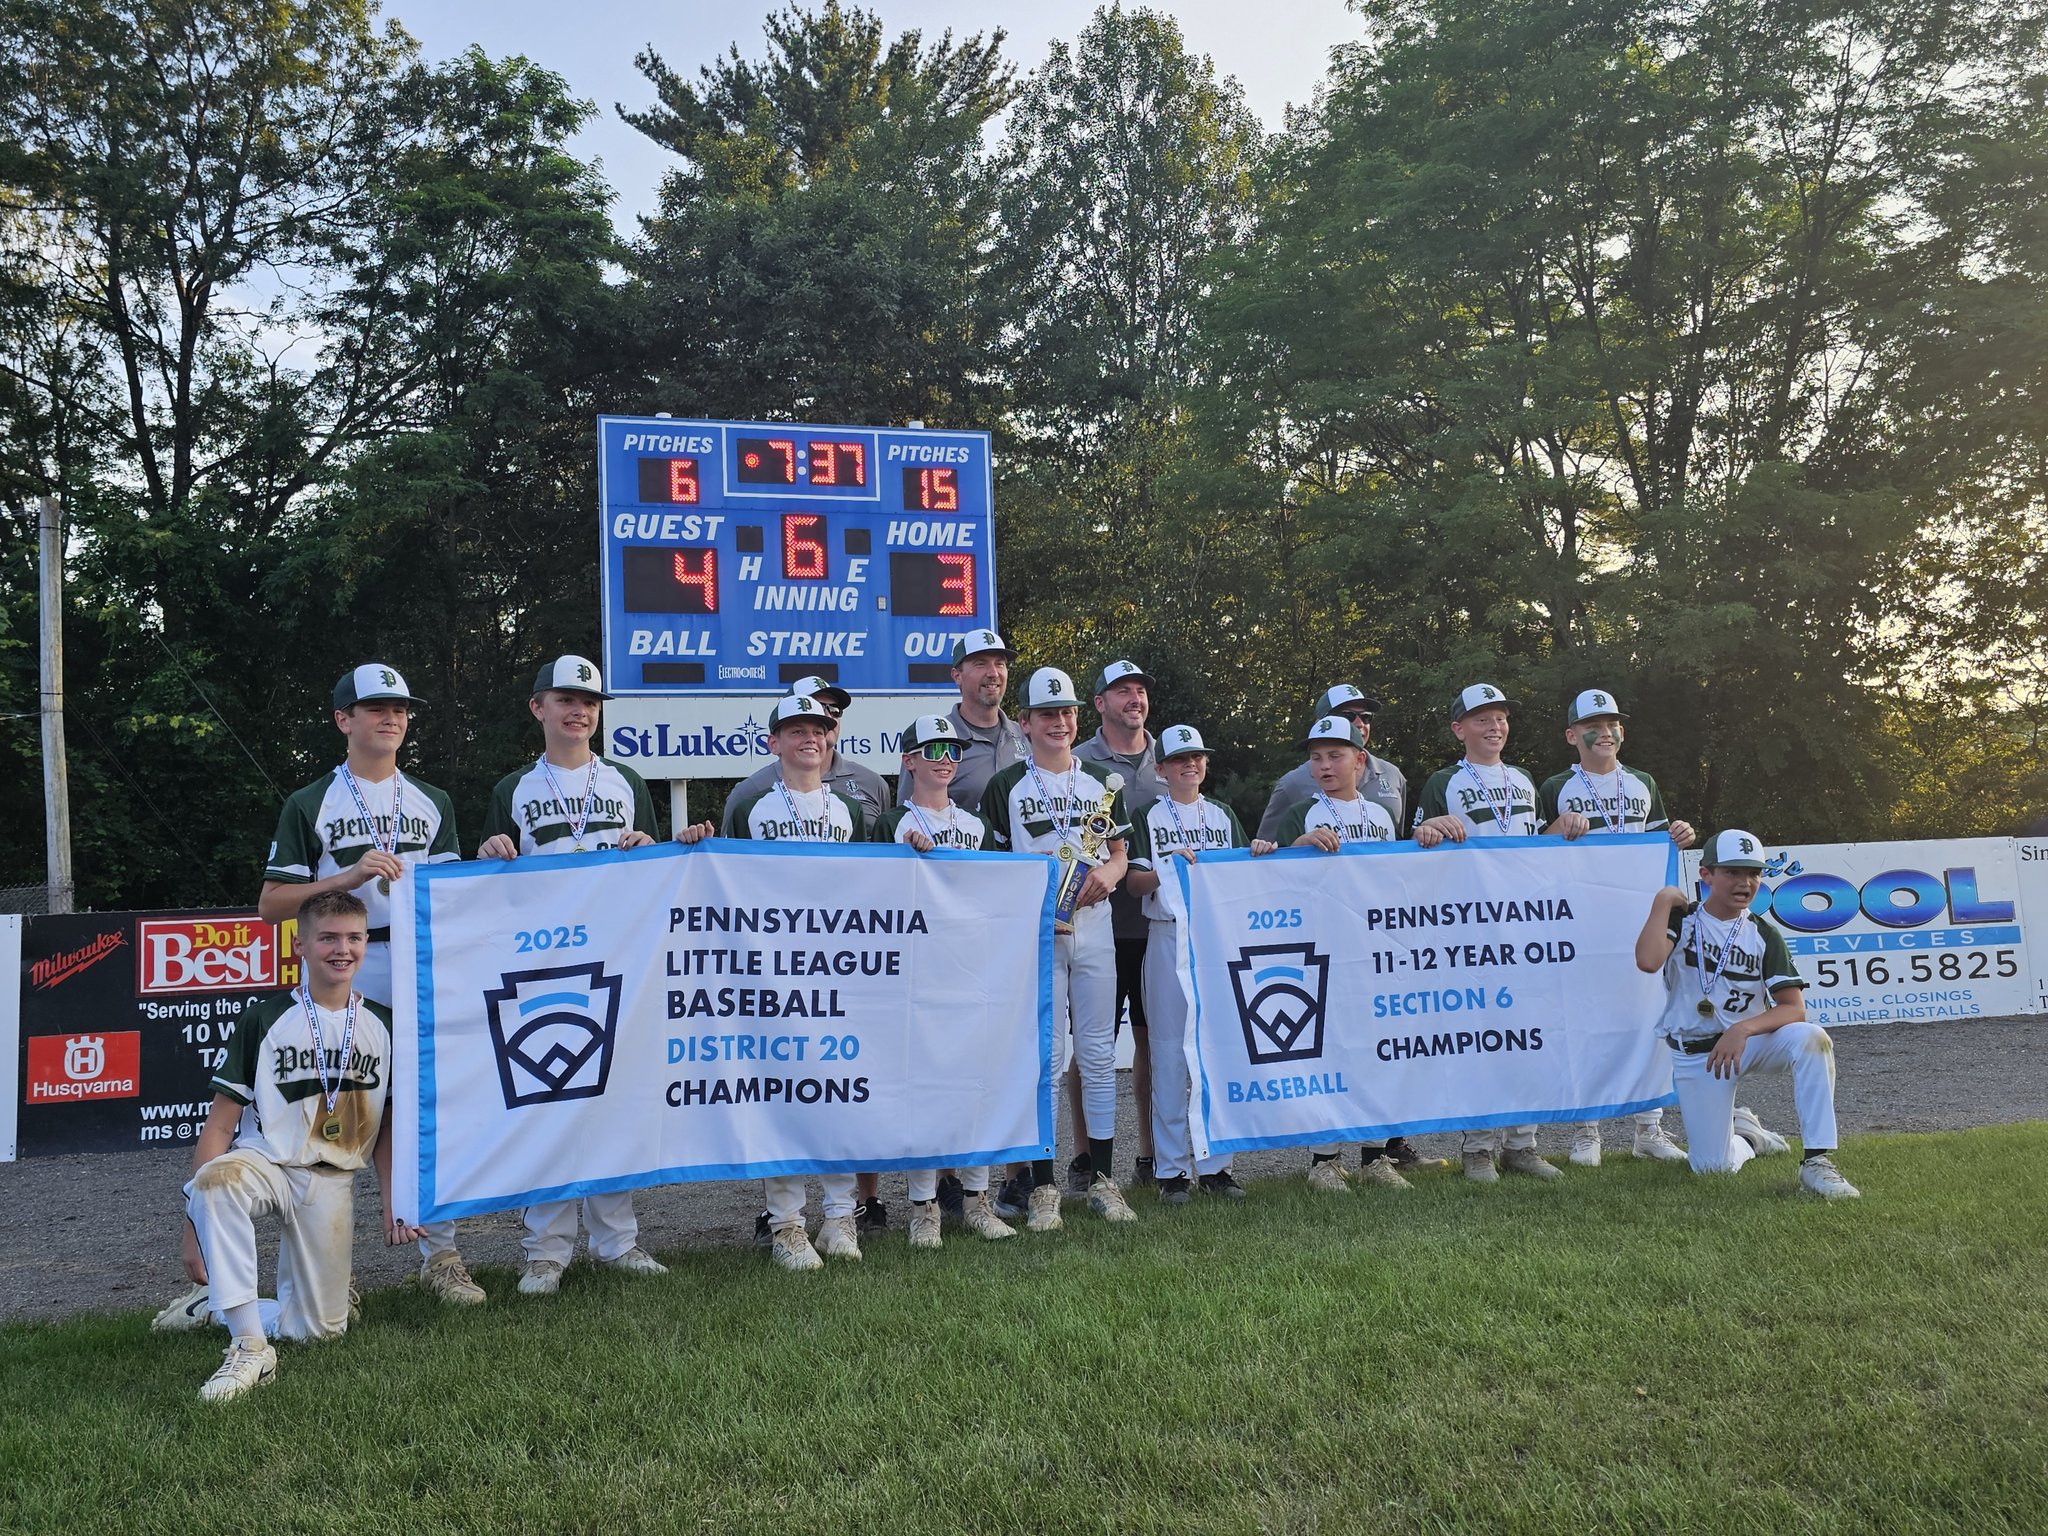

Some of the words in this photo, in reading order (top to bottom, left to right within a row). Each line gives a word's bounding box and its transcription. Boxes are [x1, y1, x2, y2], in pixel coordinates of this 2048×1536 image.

[624, 434, 713, 453] PITCHES
[887, 445, 970, 463] PITCHES
[670, 460, 697, 503] 6
[920, 468, 958, 510] 15
[613, 513, 725, 541] GUEST
[886, 522, 977, 547] HOME
[785, 515, 824, 578] 6
[674, 549, 715, 612] 4
[738, 556, 763, 581] H
[847, 559, 870, 583] E
[937, 554, 974, 615] 3
[753, 586, 859, 611] INNING
[628, 630, 718, 656] BALL
[746, 631, 868, 657] STRIKE
[904, 632, 965, 658] OUT
[521, 793, 624, 829] Pennrdge
[1566, 795, 1647, 815] Pennrdge
[324, 814, 430, 848] Pennrdge
[2021, 845, 2048, 861] Sin
[669, 906, 929, 934] PENNSYLVANIA
[1247, 908, 1303, 930] 2025
[1367, 899, 1574, 931] PENNSYLVANIA
[193, 923, 229, 948] Do
[233, 923, 251, 945] it
[514, 925, 589, 954] 2025
[1786, 930, 1975, 954] ERVICES
[28, 928, 127, 987] Milwaukee
[147, 934, 270, 988] Best
[666, 949, 762, 976] LITTLE
[774, 950, 900, 976] LEAGUE
[1372, 948, 1437, 974] 11-12
[1444, 943, 1517, 968] YEAR
[1524, 941, 1576, 963] OLD
[1804, 949, 2018, 988] .516.5825
[216, 998, 242, 1015] the
[667, 988, 846, 1020] BASEBALL
[1373, 987, 1486, 1018] SECTION
[1495, 986, 1513, 1009] 6
[1723, 989, 1755, 1013] 27
[1805, 996, 1862, 1009] NINGS
[1882, 989, 1973, 1005] CLOSINGS
[1818, 1012, 1831, 1024] &
[1836, 1009, 1890, 1023] LINER
[1896, 1003, 1981, 1019] INSTALLS
[182, 1023, 211, 1043] 10
[1376, 1028, 1543, 1062] CHAMPIONS
[273, 1043, 382, 1081] Pennrdge
[667, 1034, 809, 1064] DISTRICT
[819, 1035, 860, 1061] 20
[33, 1079, 134, 1099] Husqvarna
[665, 1076, 870, 1108] CHAMPIONS
[1227, 1072, 1348, 1103] BASEBALL
[140, 1101, 214, 1120] www.m
